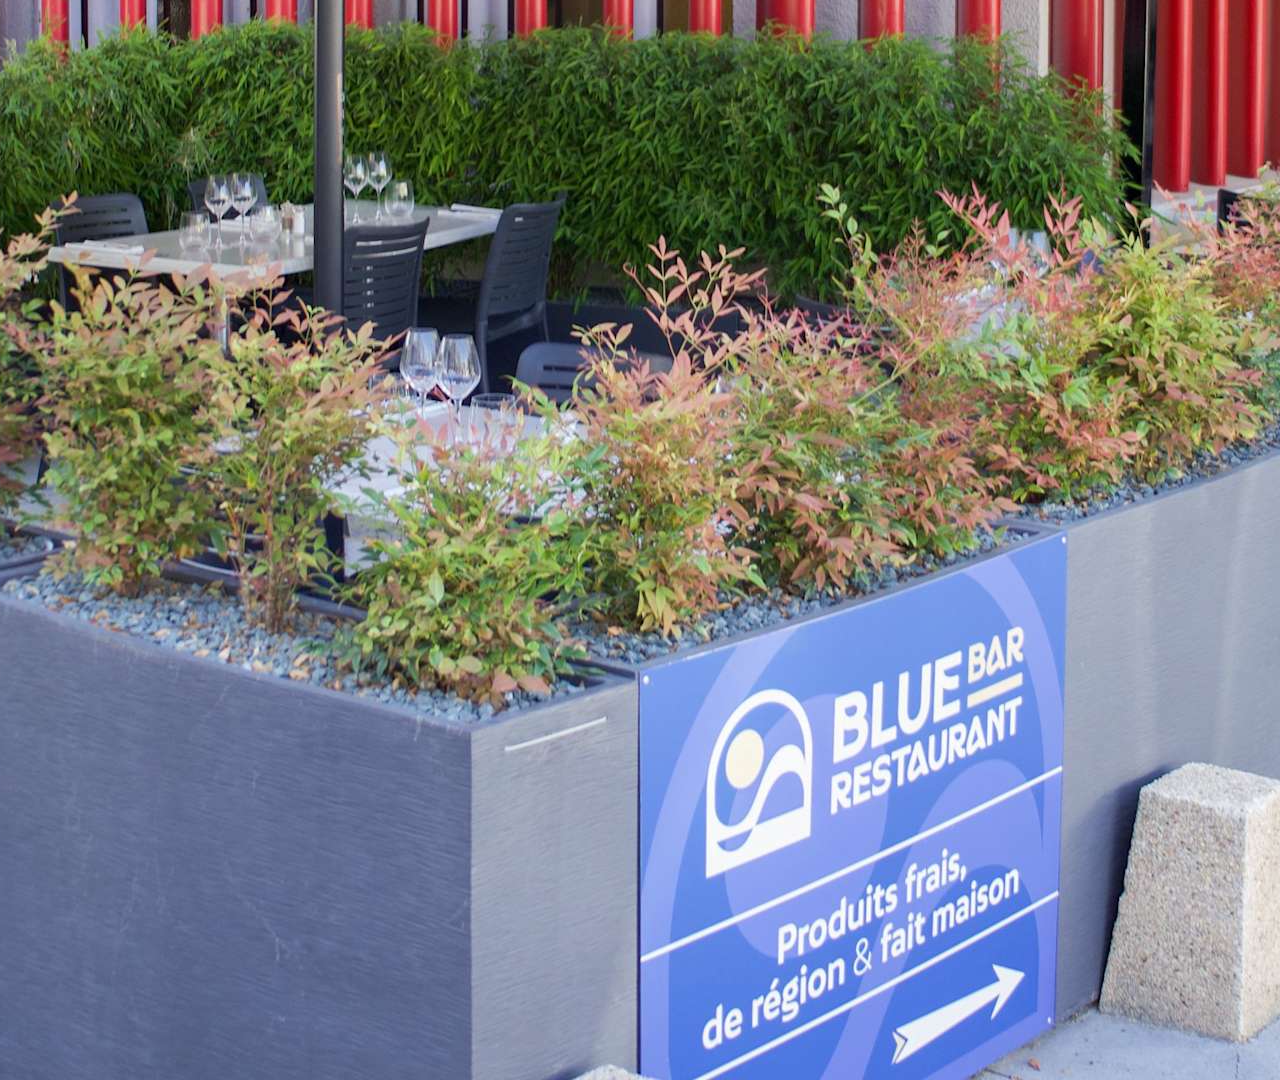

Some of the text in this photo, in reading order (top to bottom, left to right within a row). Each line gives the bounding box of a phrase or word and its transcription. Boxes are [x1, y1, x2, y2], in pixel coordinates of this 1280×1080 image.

[830, 696, 1022, 816] RESTAURANT
[832, 626, 1024, 764] BLUE BAR
[702, 868, 1019, 1050] de région & fait maison
[777, 848, 967, 965] Produits frais,
